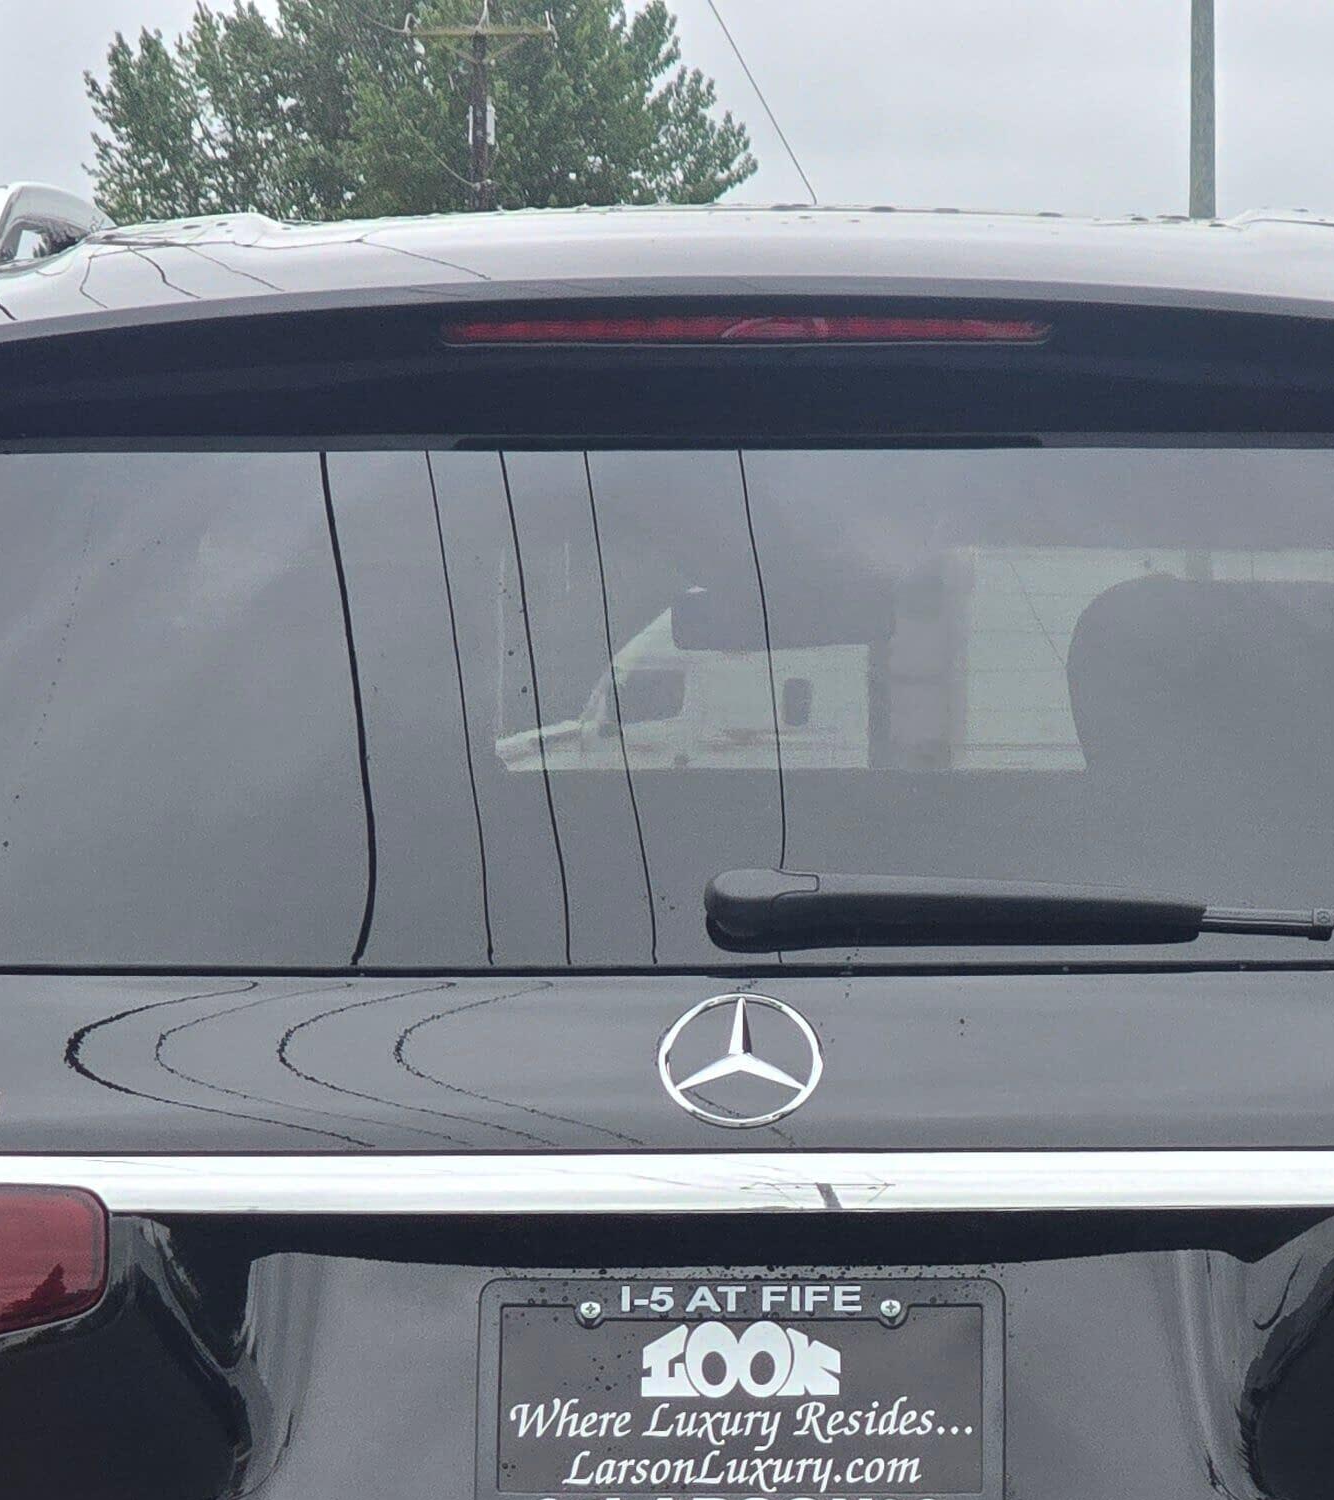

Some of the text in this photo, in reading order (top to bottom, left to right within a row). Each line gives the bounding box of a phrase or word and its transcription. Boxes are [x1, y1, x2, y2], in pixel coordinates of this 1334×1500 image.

[621, 1285, 864, 1313] I-5 AT FIFE
[509, 1395, 974, 1451] Where Luxury Resides...
[562, 1450, 922, 1493] LarsonLuxury.com
